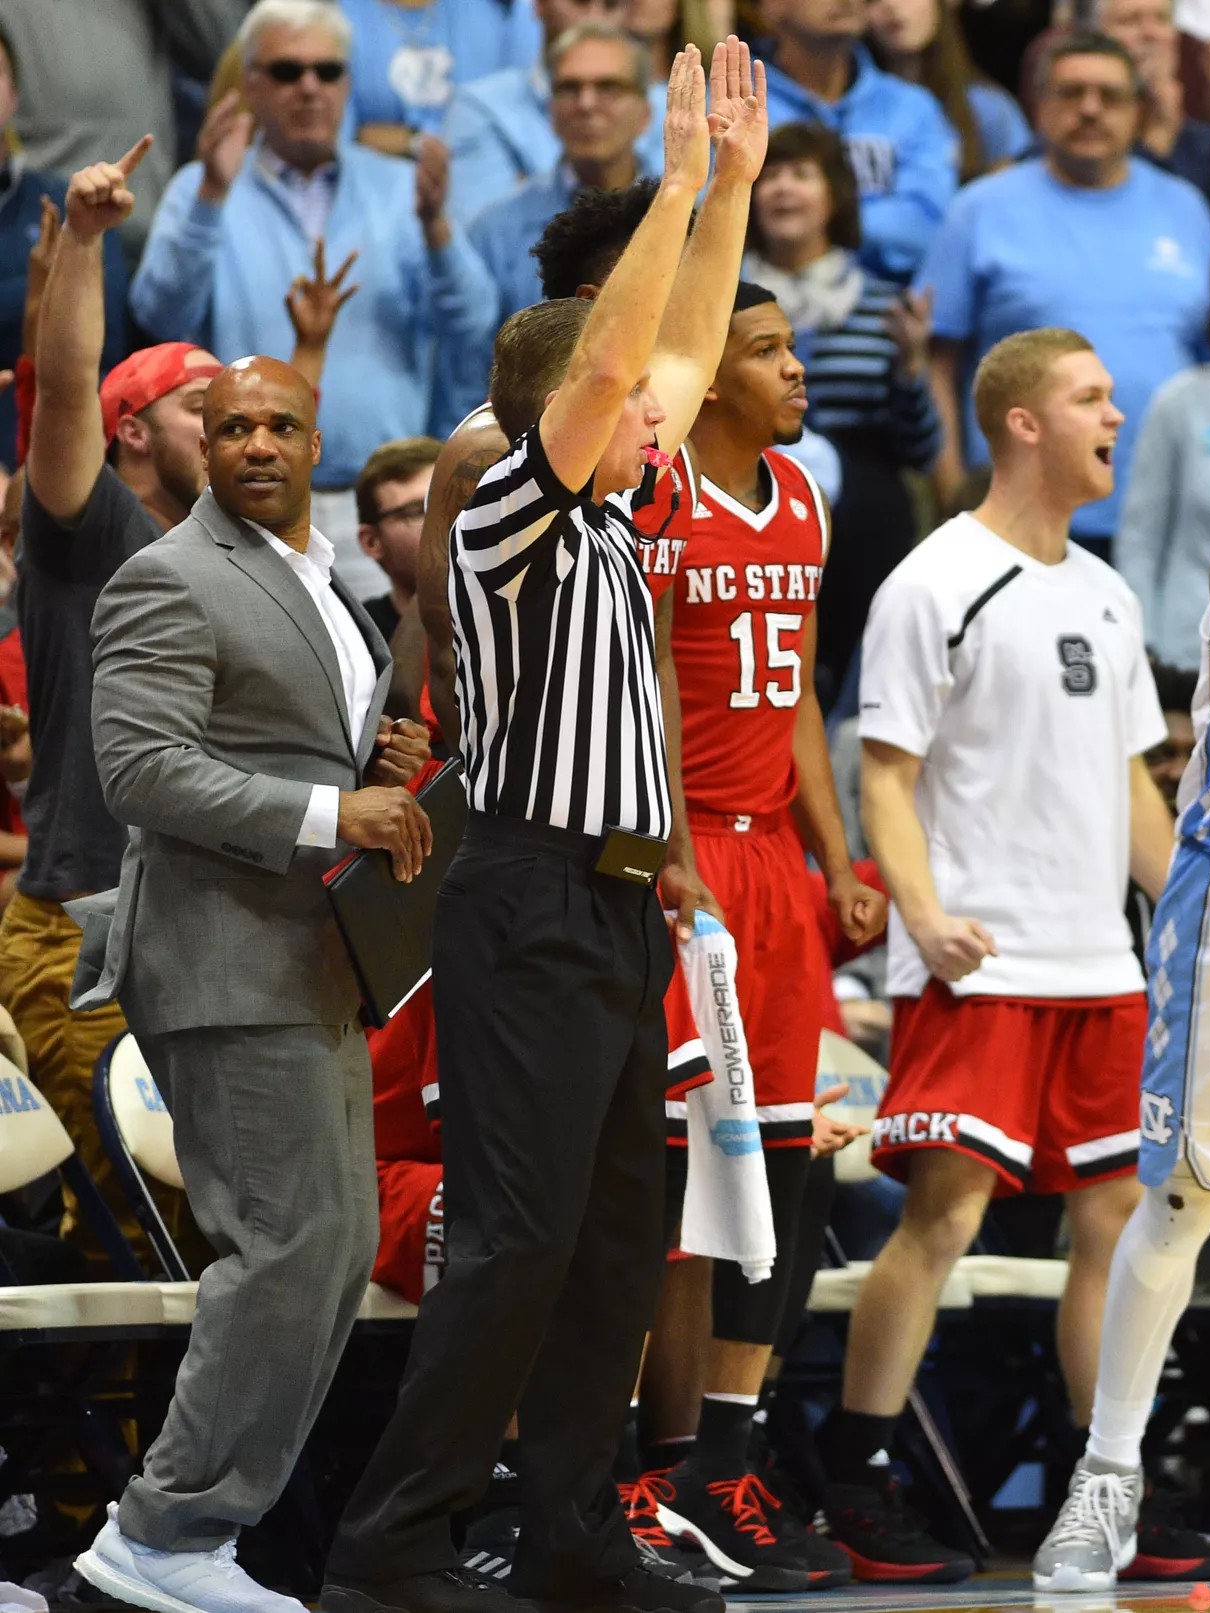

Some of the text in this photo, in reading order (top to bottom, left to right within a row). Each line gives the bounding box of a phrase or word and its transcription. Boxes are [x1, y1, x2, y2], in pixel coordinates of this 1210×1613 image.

[637, 538, 687, 575] TAT
[685, 564, 823, 603] NC STAT
[729, 611, 803, 708] 15
[707, 952, 748, 1106] POWERADE
[872, 1111, 958, 1148] PACK
[424, 1181, 445, 1263] PAC
